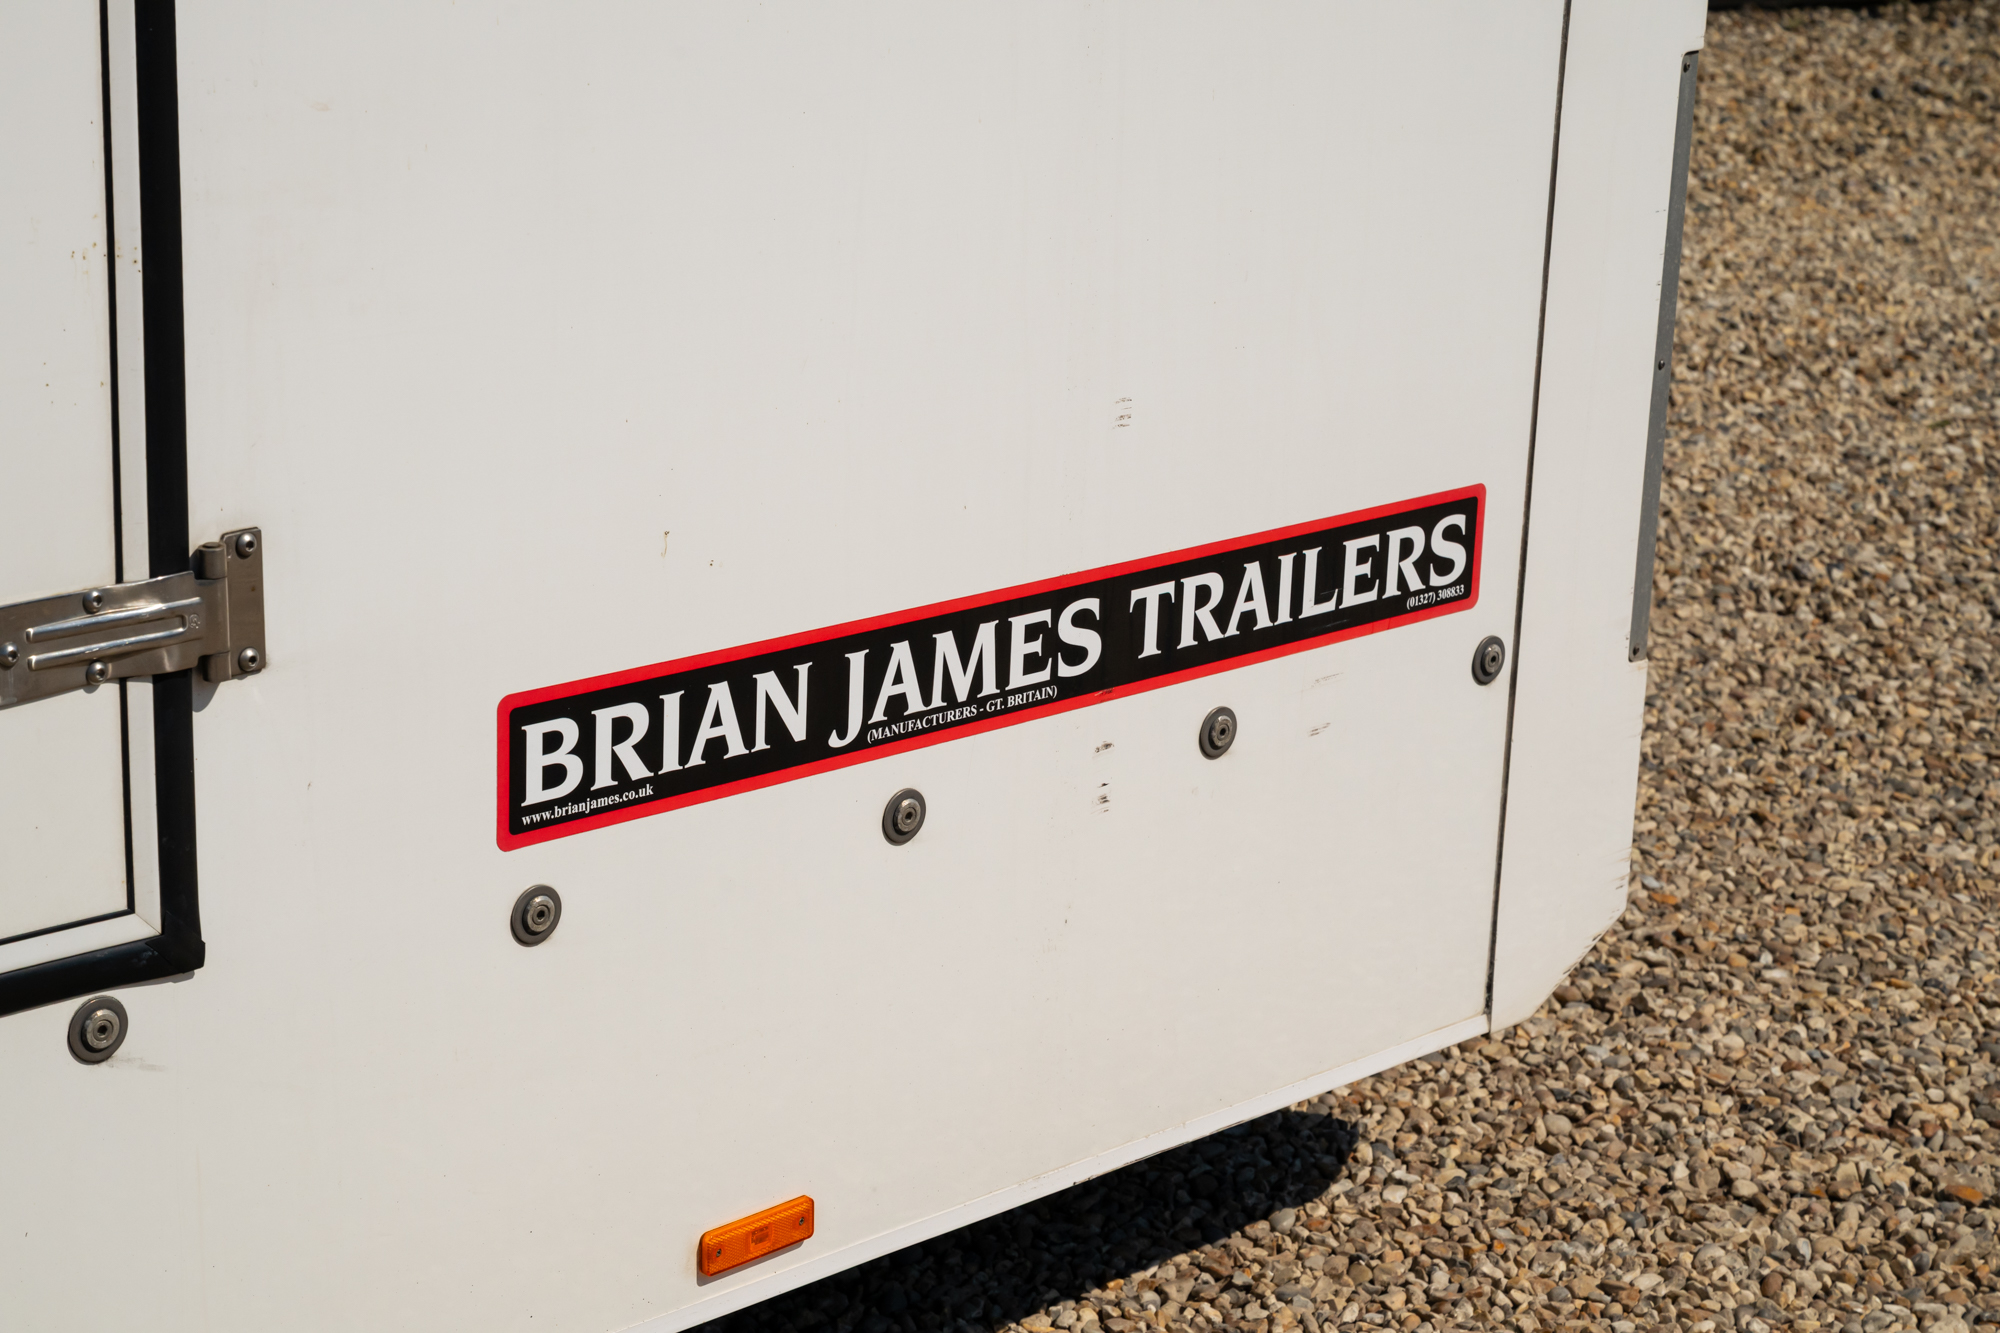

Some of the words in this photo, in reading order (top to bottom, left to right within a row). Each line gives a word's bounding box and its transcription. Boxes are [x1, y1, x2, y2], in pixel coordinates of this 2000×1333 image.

[1406, 591, 1436, 611] (01327)
[1437, 584, 1465, 601] 308833
[521, 662, 813, 807] BRIAN
[828, 597, 1102, 749] JAMES
[1129, 513, 1467, 660] TRAILERS
[867, 704, 978, 744] (MANUFACTURERS
[986, 697, 1006, 714] GT.
[1006, 685, 1058, 710] BRITAIN)
[521, 783, 654, 826] www.brianjames.co.uk
